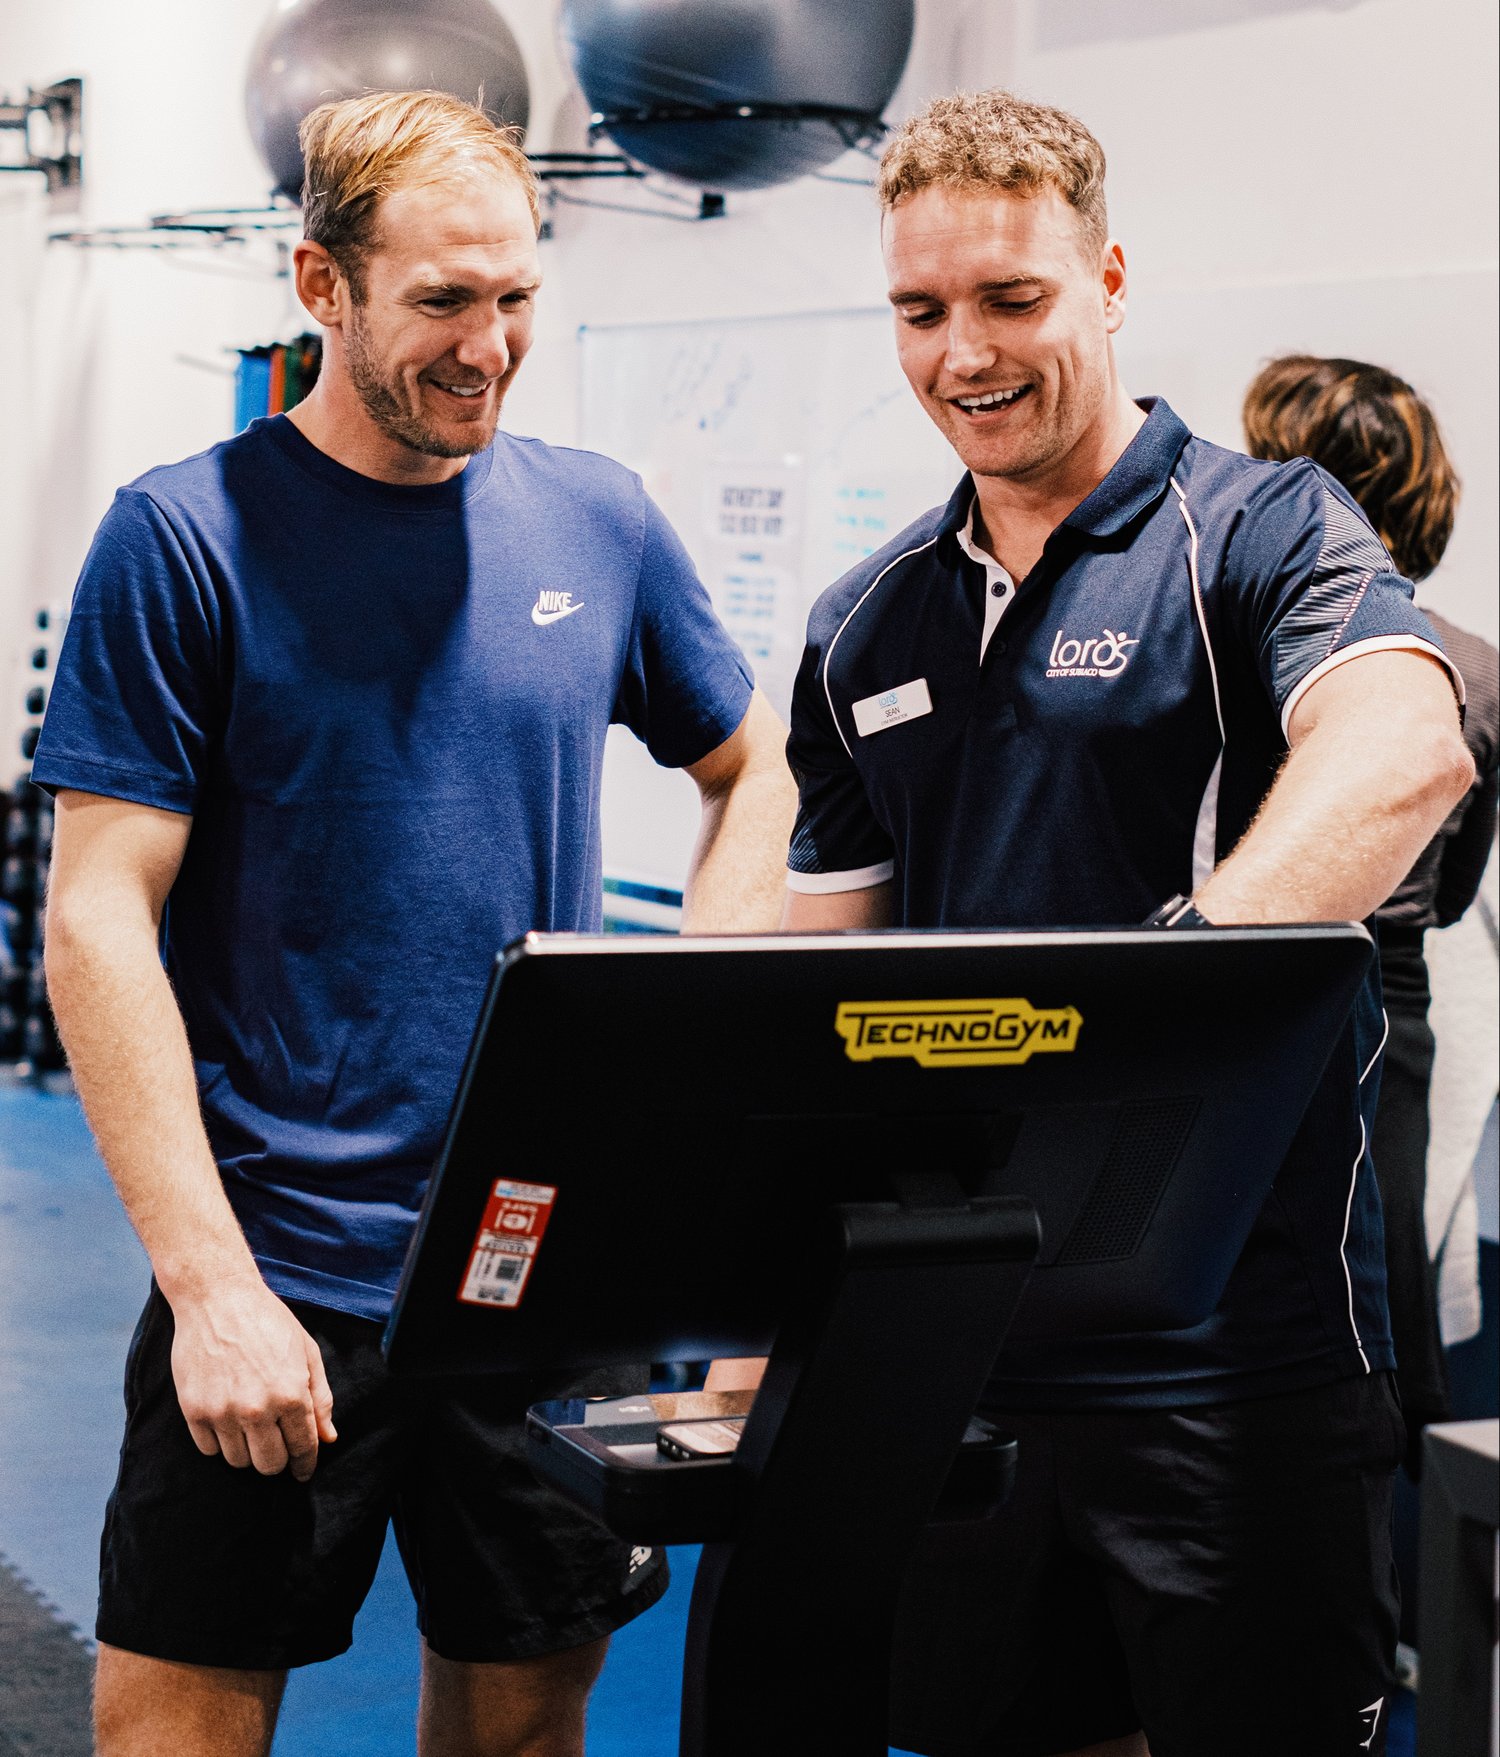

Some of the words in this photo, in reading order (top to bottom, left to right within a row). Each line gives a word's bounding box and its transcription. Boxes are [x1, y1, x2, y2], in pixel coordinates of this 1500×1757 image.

[538, 590, 572, 611] NIKE
[1060, 669, 1069, 677] OF
[885, 707, 900, 718] SEAN
